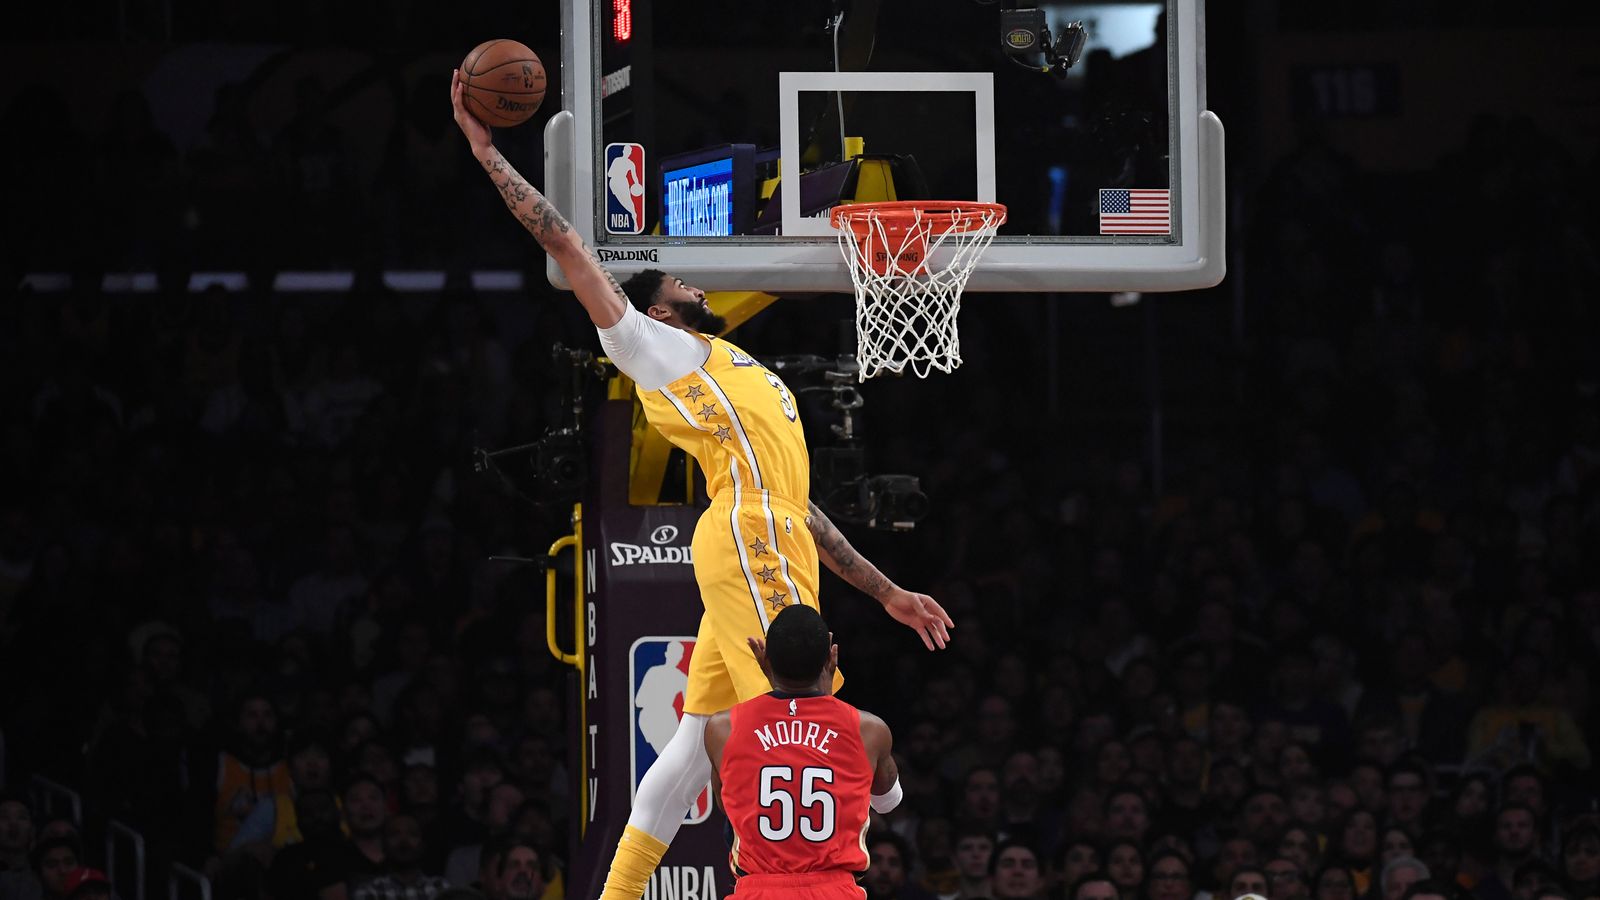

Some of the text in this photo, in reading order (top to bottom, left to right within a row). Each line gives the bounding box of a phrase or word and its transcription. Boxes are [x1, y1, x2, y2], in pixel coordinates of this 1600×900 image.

[611, 213, 630, 228] NBA
[597, 249, 659, 262] SPALDING
[764, 371, 797, 423] 3
[610, 542, 693, 566] SPALDI
[586, 548, 598, 822] NBA TV
[754, 720, 839, 755] MOORE
[758, 765, 836, 842] 55
